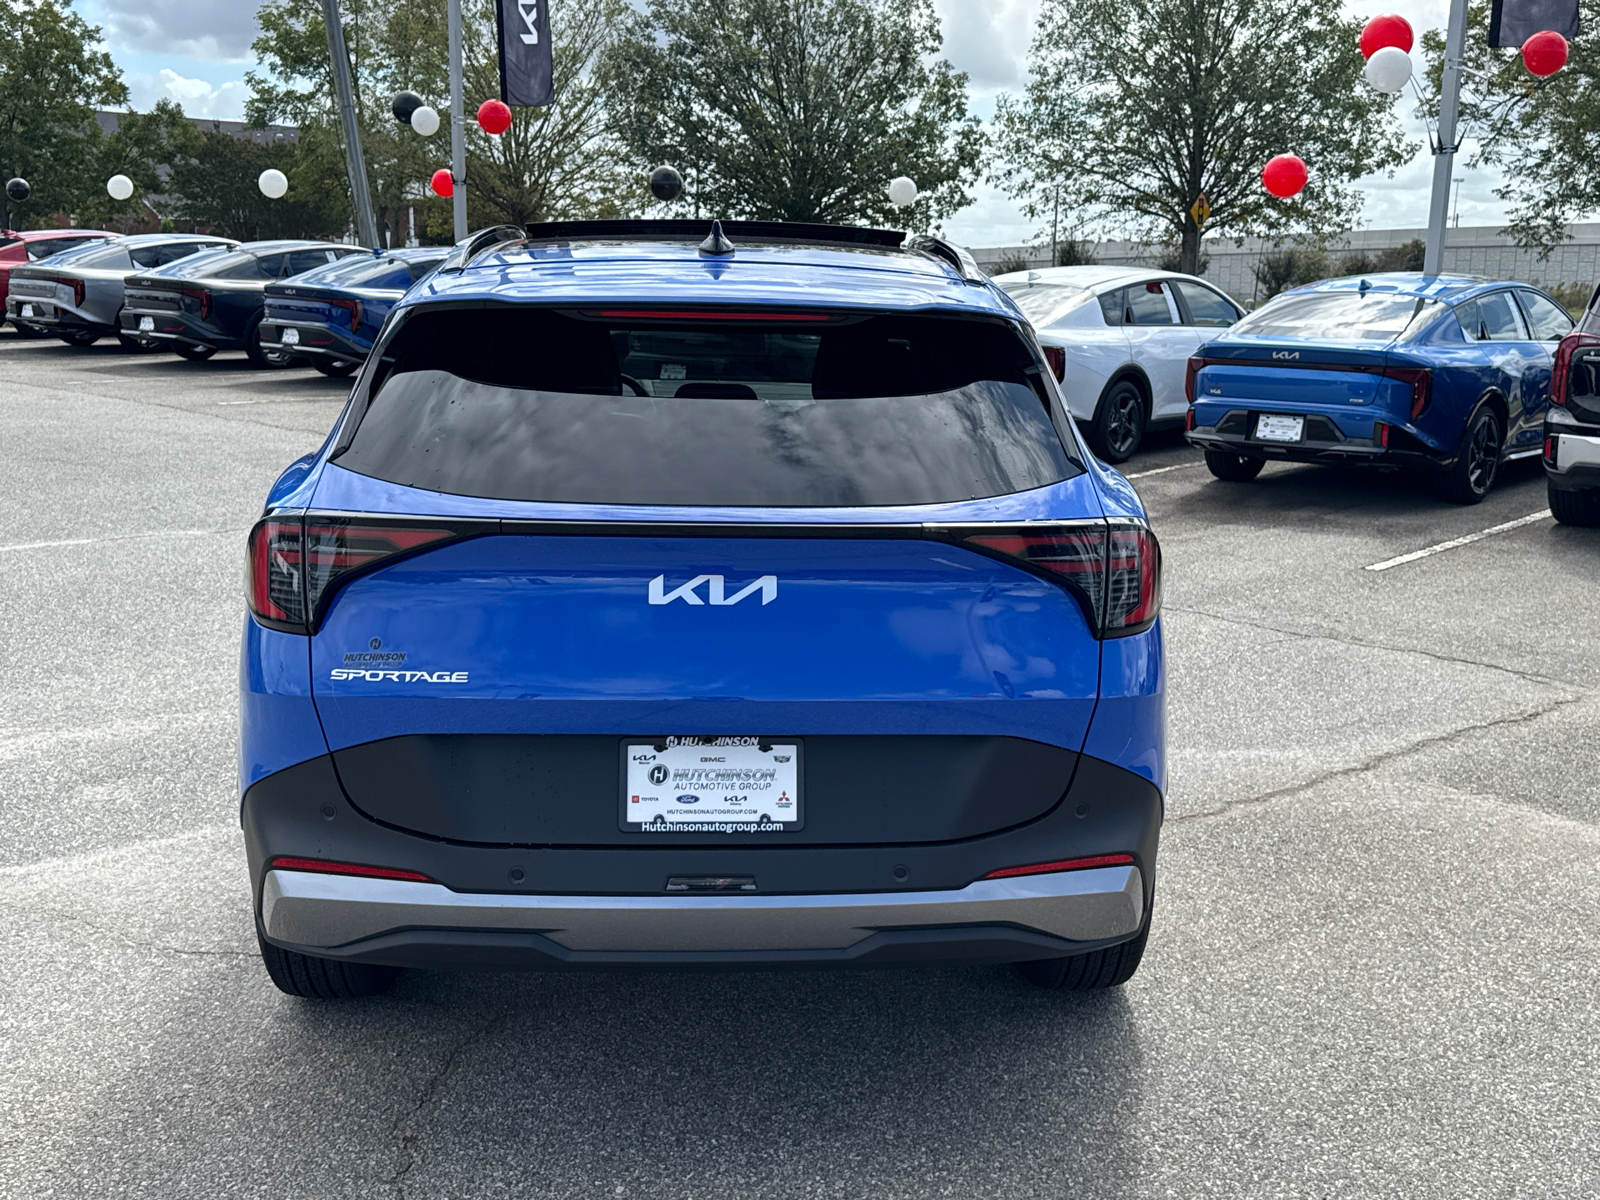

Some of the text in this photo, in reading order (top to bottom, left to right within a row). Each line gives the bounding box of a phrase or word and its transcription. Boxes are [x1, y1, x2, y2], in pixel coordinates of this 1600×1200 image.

[518, 0, 538, 44] KI
[1272, 351, 1300, 360] KIA
[648, 574, 777, 606] KIA
[344, 653, 406, 661] HUTCHINSON
[330, 669, 469, 683] SPORTAGE
[672, 768, 776, 781] HUTCHINSON
[673, 782, 772, 791] AUTOMOTIVE GROUP
[641, 821, 784, 833] Hutchinsonautogroup.com
